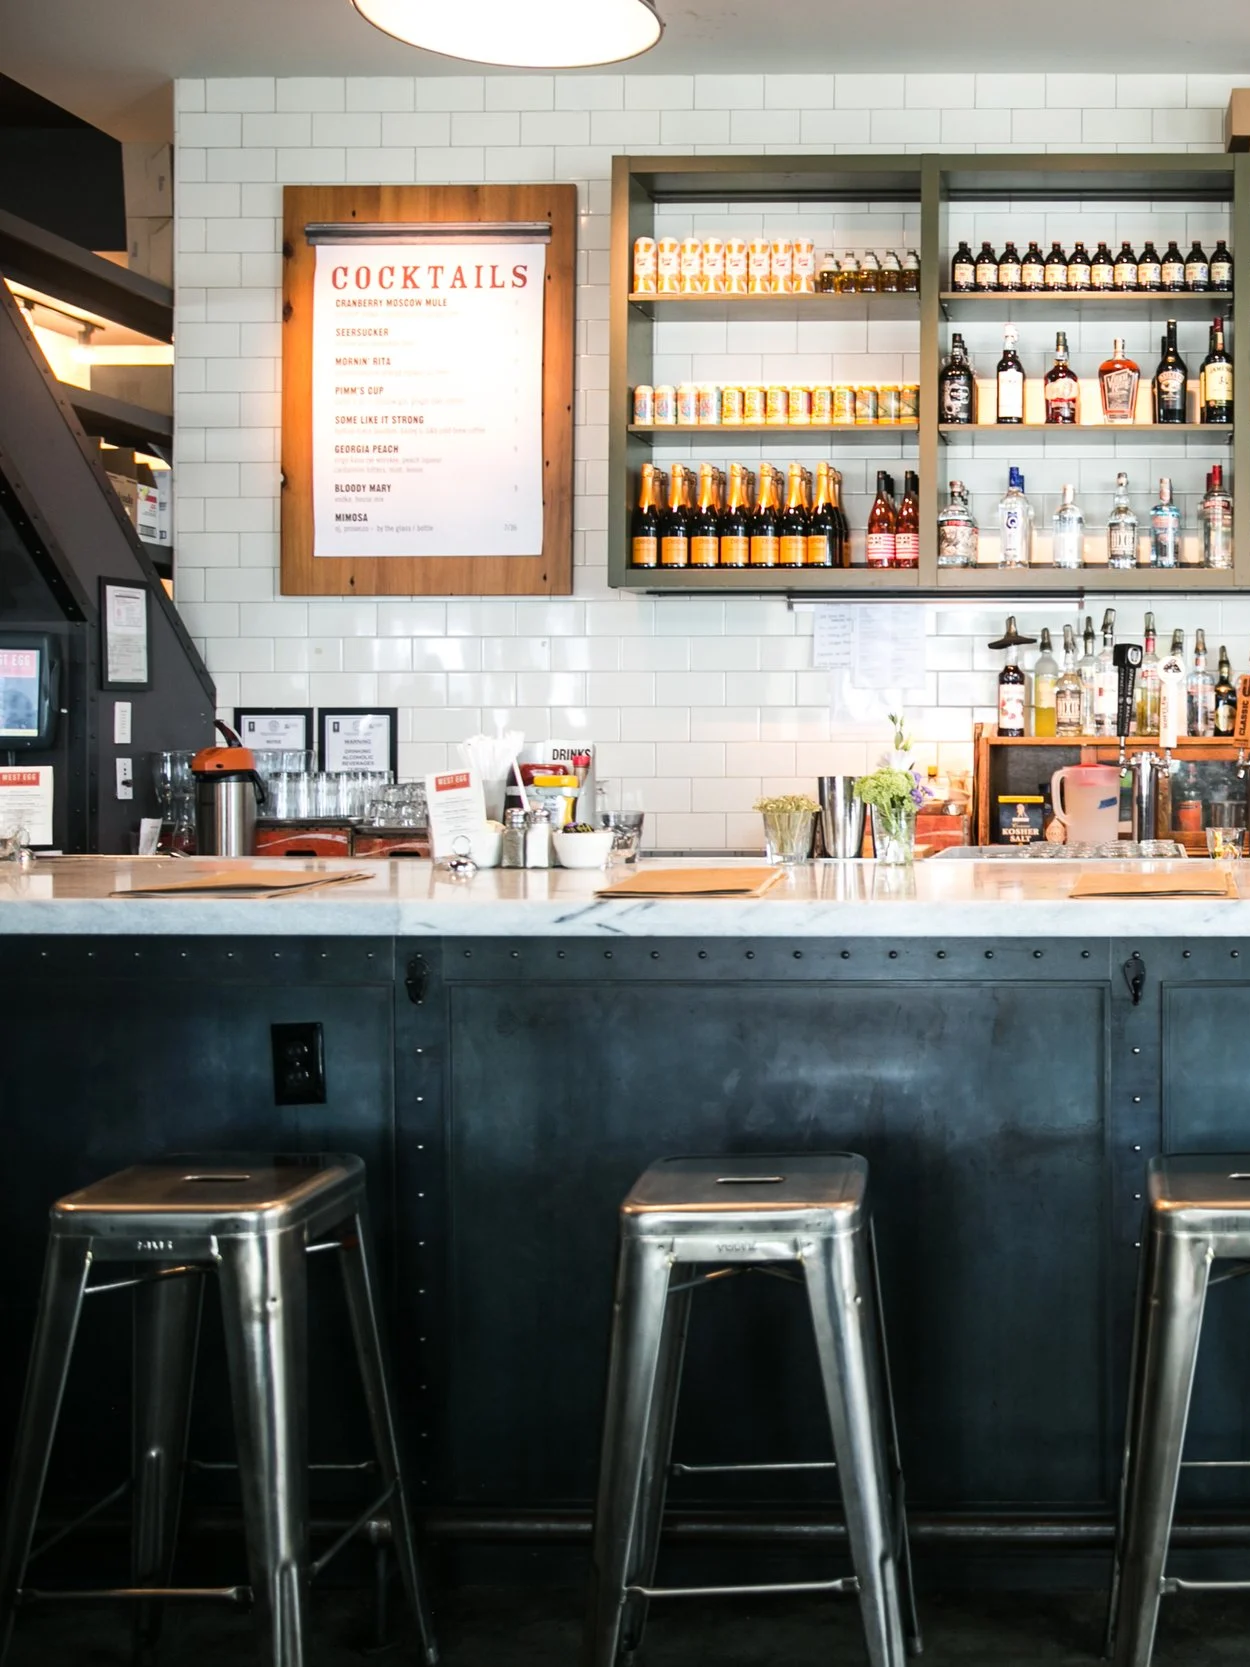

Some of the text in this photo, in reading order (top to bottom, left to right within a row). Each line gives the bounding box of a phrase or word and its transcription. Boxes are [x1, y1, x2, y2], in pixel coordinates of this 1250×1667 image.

[331, 264, 528, 290] COCKTAILS
[335, 298, 448, 308] CRANBERRY MOSCOW MULE
[335, 328, 389, 337] SEERSUCKER
[335, 357, 391, 366] MORNIN' RITA
[335, 386, 384, 396] PIMM'S CUP
[335, 415, 424, 425] SOME LIKE IT STRONG
[335, 445, 399, 454] GEORGIA PEACH
[334, 483, 392, 493] BLOODY MARY
[335, 513, 368, 522] MIMOSA
[12, 654, 31, 667] EGG
[1238, 700, 1249, 736] CLASSIC
[1, 773, 37, 781] WEST EGG
[437, 774, 468, 786] WEST EGG
[1001, 827, 1040, 836] KOSHER
[1009, 835, 1032, 843] SALT
